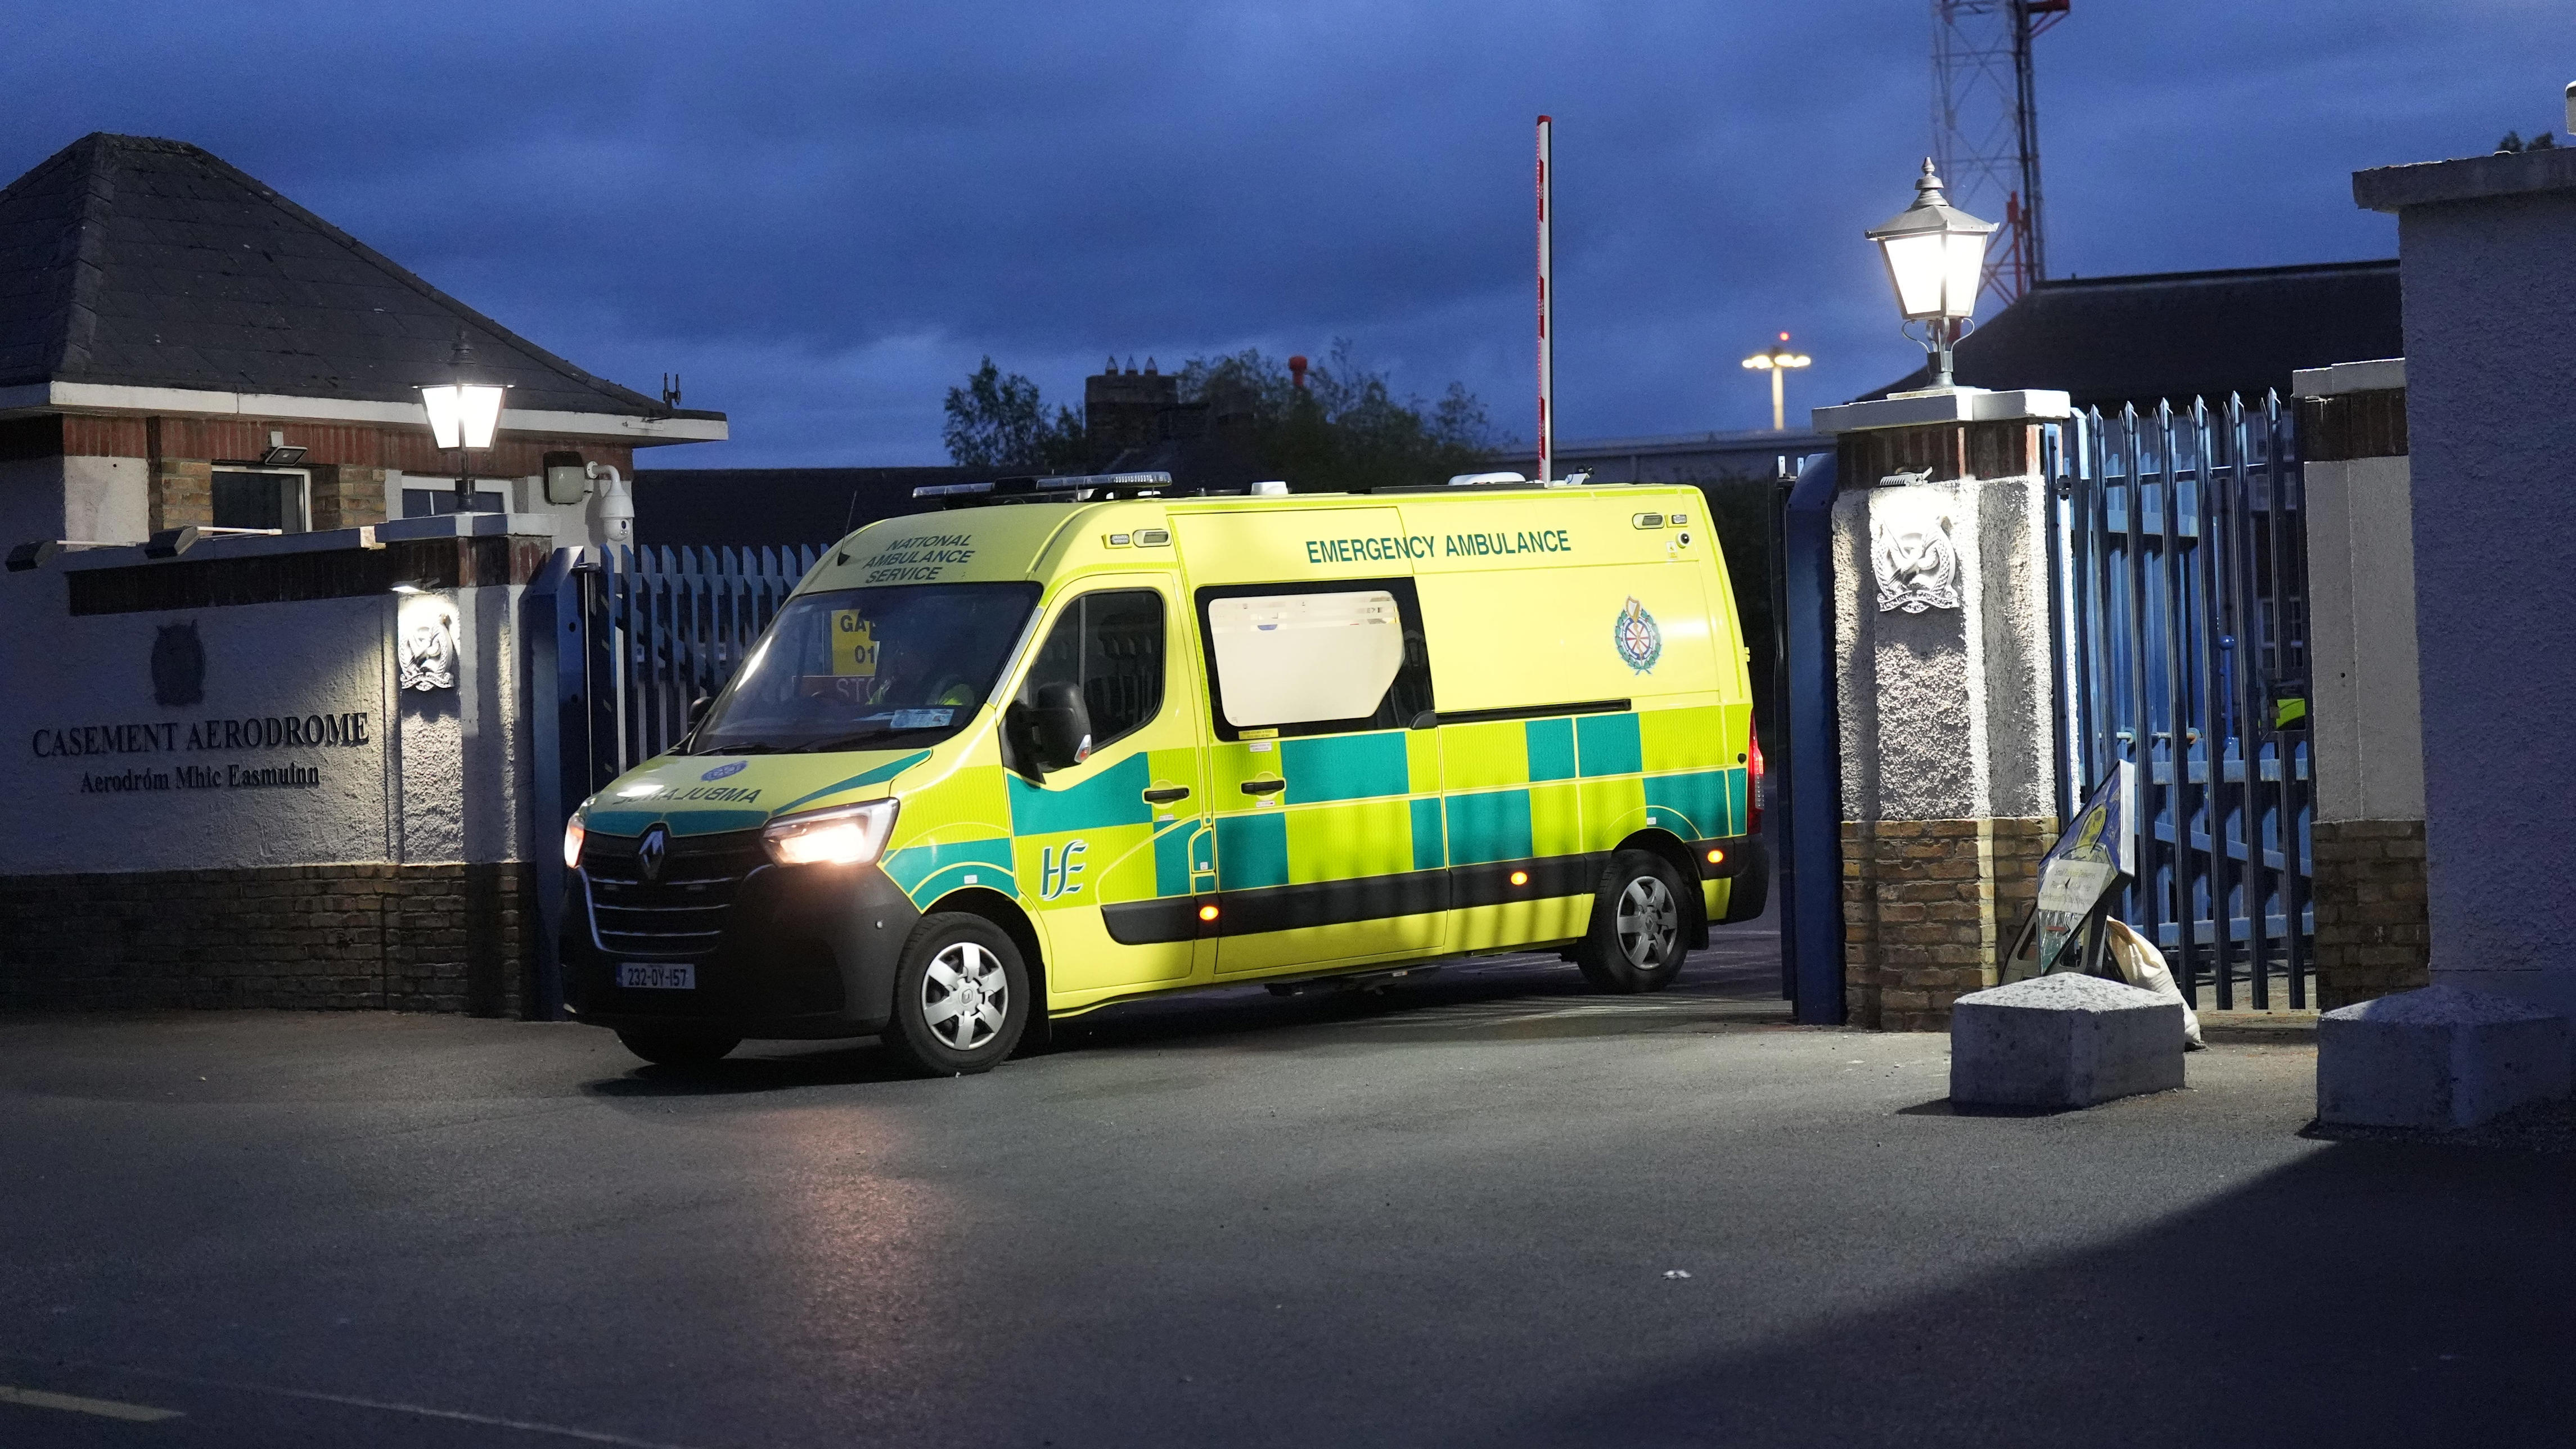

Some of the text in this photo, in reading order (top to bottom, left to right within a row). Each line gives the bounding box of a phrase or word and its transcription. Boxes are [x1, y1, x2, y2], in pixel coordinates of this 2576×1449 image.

[887, 534, 972, 550] NATIONAL
[1306, 530, 1571, 564] EMERGENCY AMBULANCE
[862, 550, 976, 569] AMBULANCE
[864, 566, 943, 584] SERVICE
[31, 712, 370, 758] CASEMENT AERODROME
[80, 767, 169, 793] Aerodróm
[175, 764, 222, 789] Mhic
[1041, 840, 1087, 899] HSE
[627, 968, 687, 987] 232-OY-157
